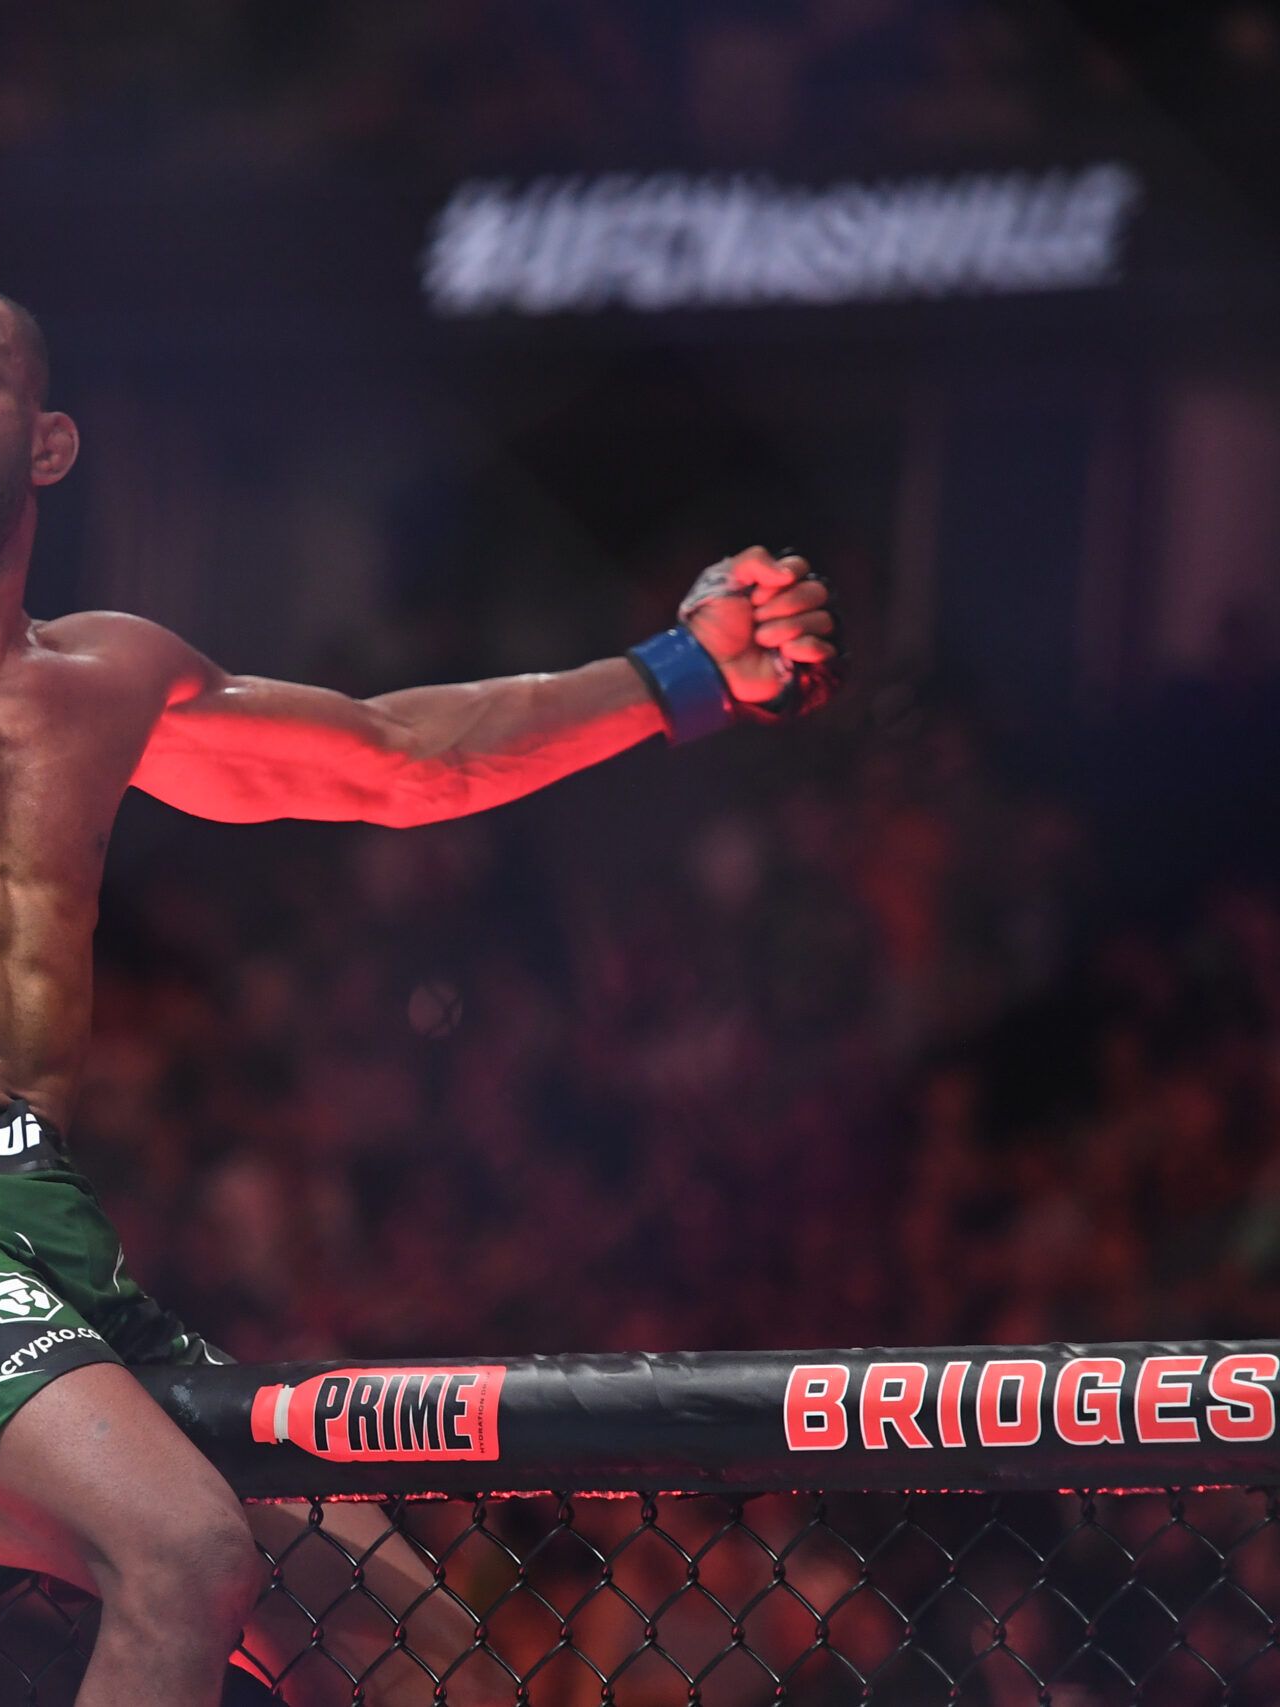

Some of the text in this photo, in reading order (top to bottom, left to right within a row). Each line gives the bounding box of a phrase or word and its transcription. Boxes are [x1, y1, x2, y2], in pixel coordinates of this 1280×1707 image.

[0, 1327, 106, 1376] crypto.co
[313, 1373, 480, 1453] PRIME
[477, 1398, 485, 1454] HYDRATION
[783, 1353, 1280, 1452] BRIDGES
